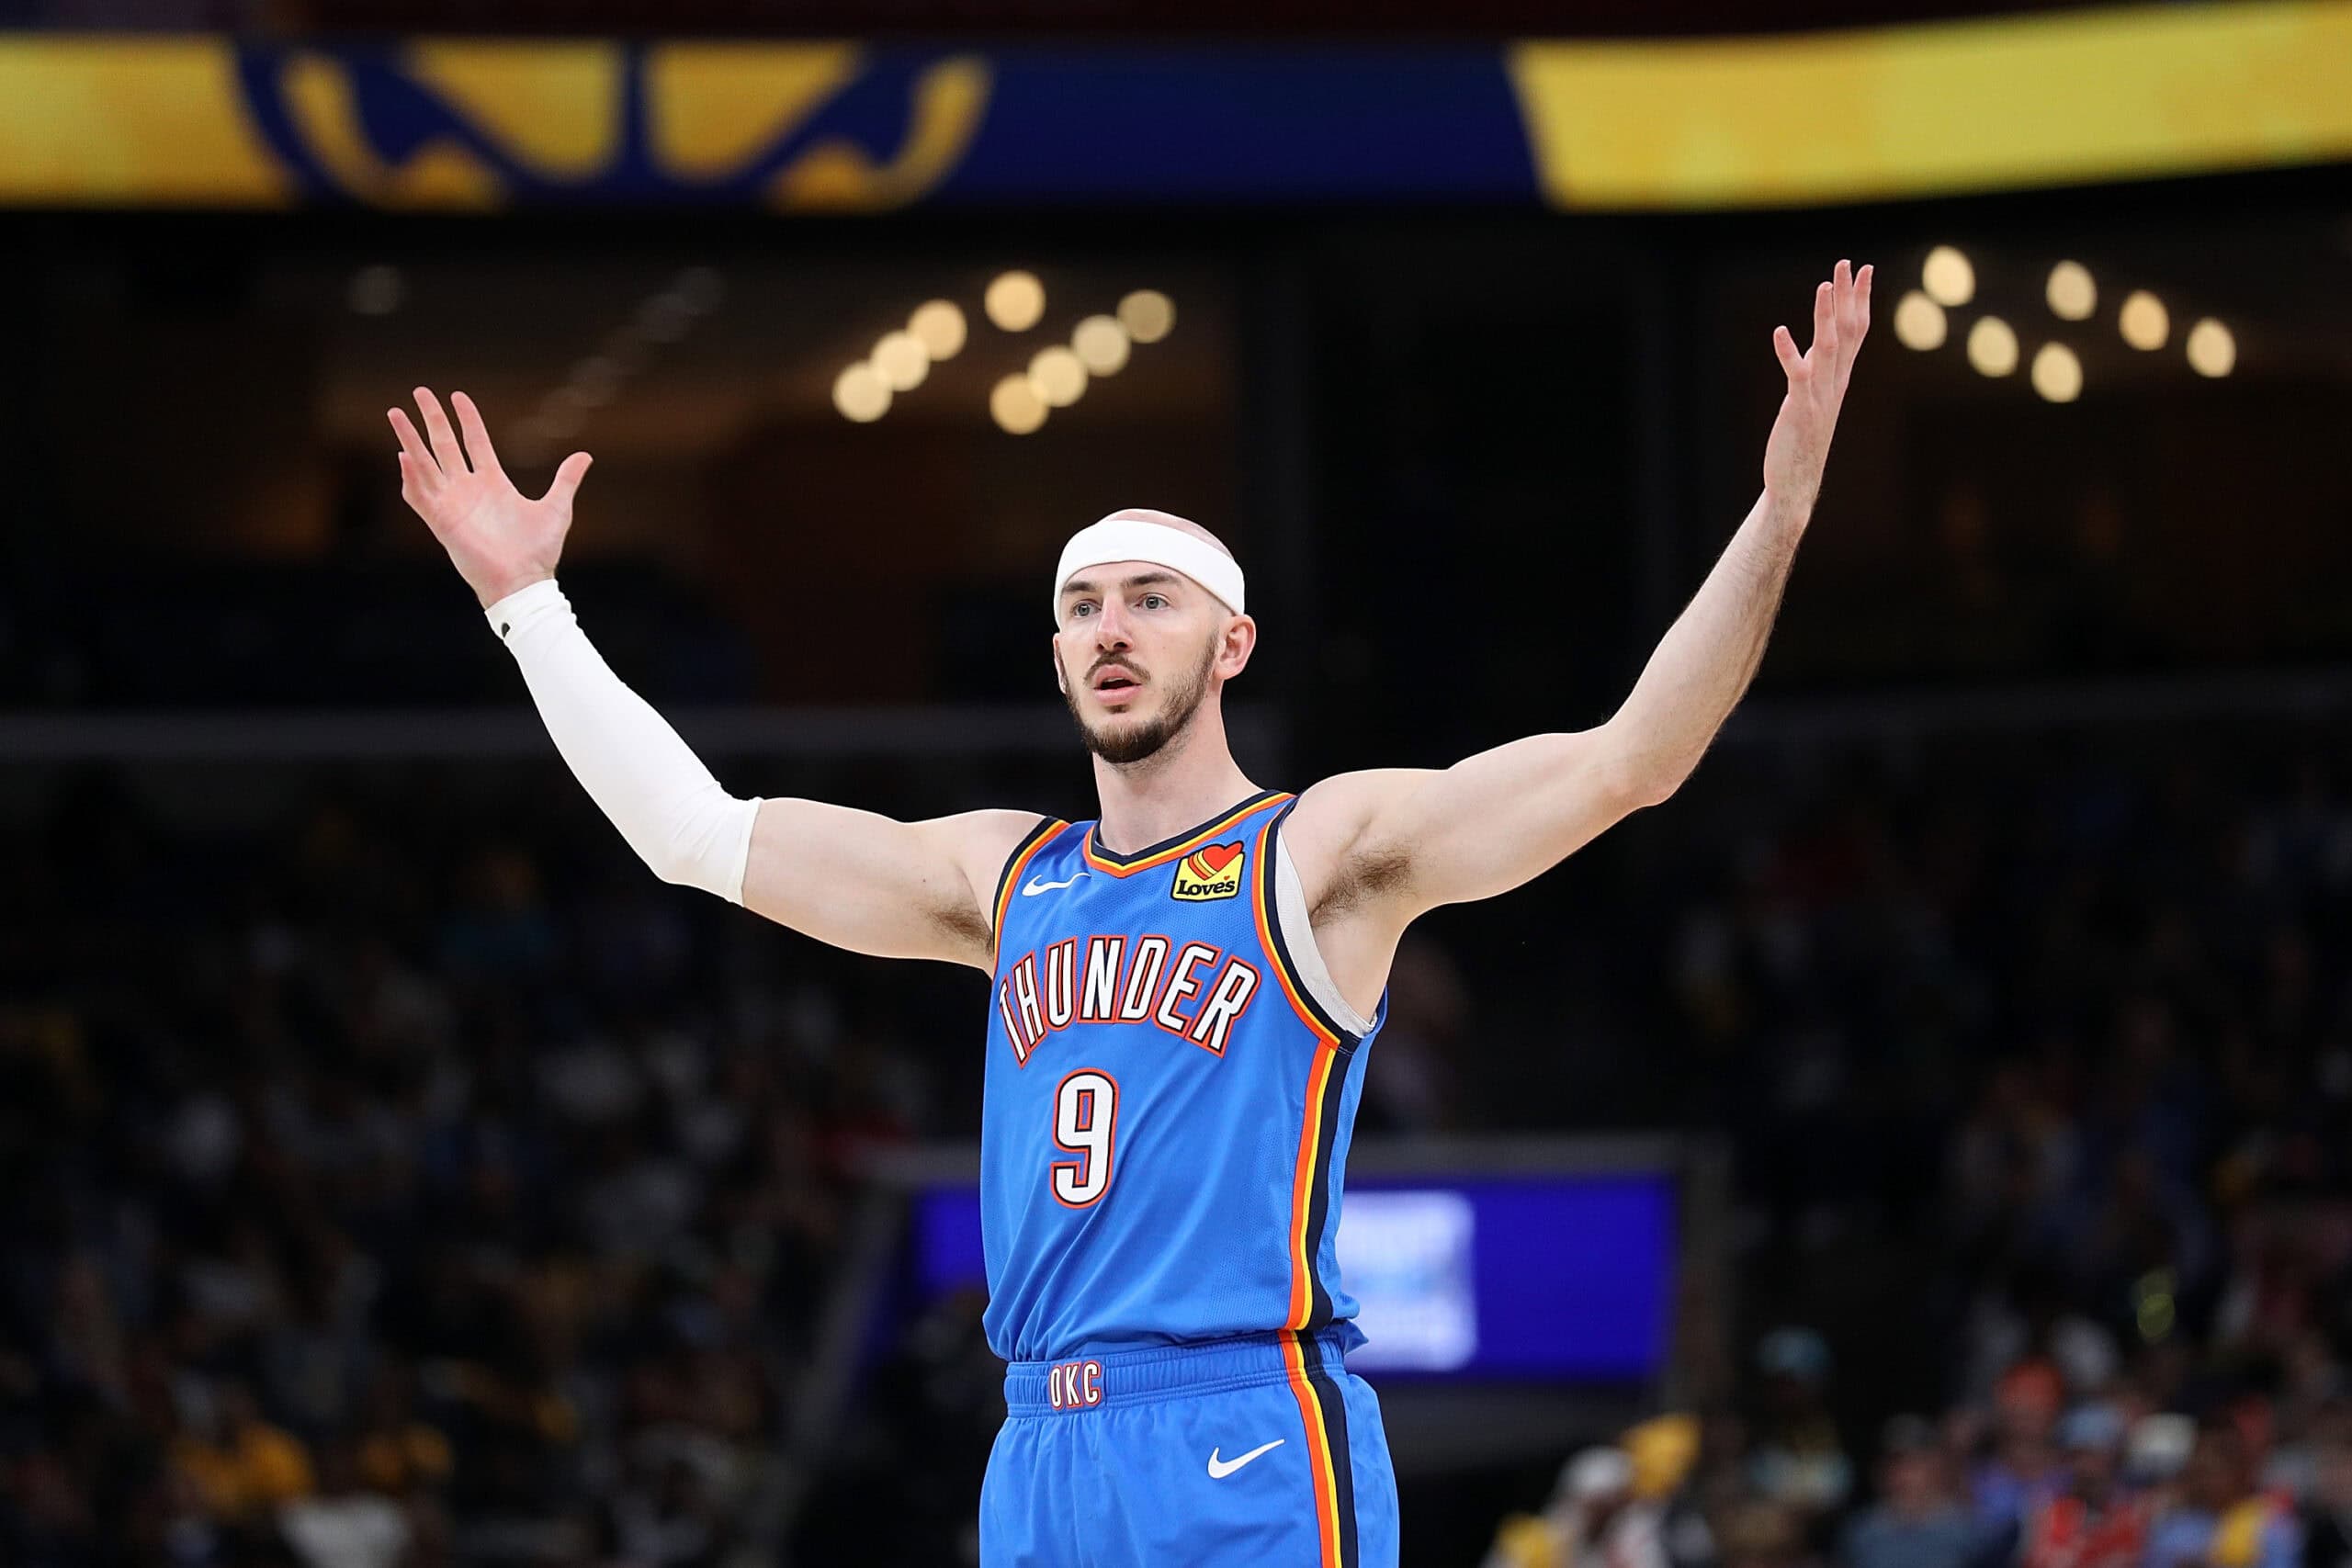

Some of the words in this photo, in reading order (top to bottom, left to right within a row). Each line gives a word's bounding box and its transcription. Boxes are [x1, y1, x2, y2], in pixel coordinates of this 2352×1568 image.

[999, 935, 1262, 1069] THUNDER
[1050, 1067, 1120, 1210] 9
[1049, 1360, 1102, 1411] OKC
